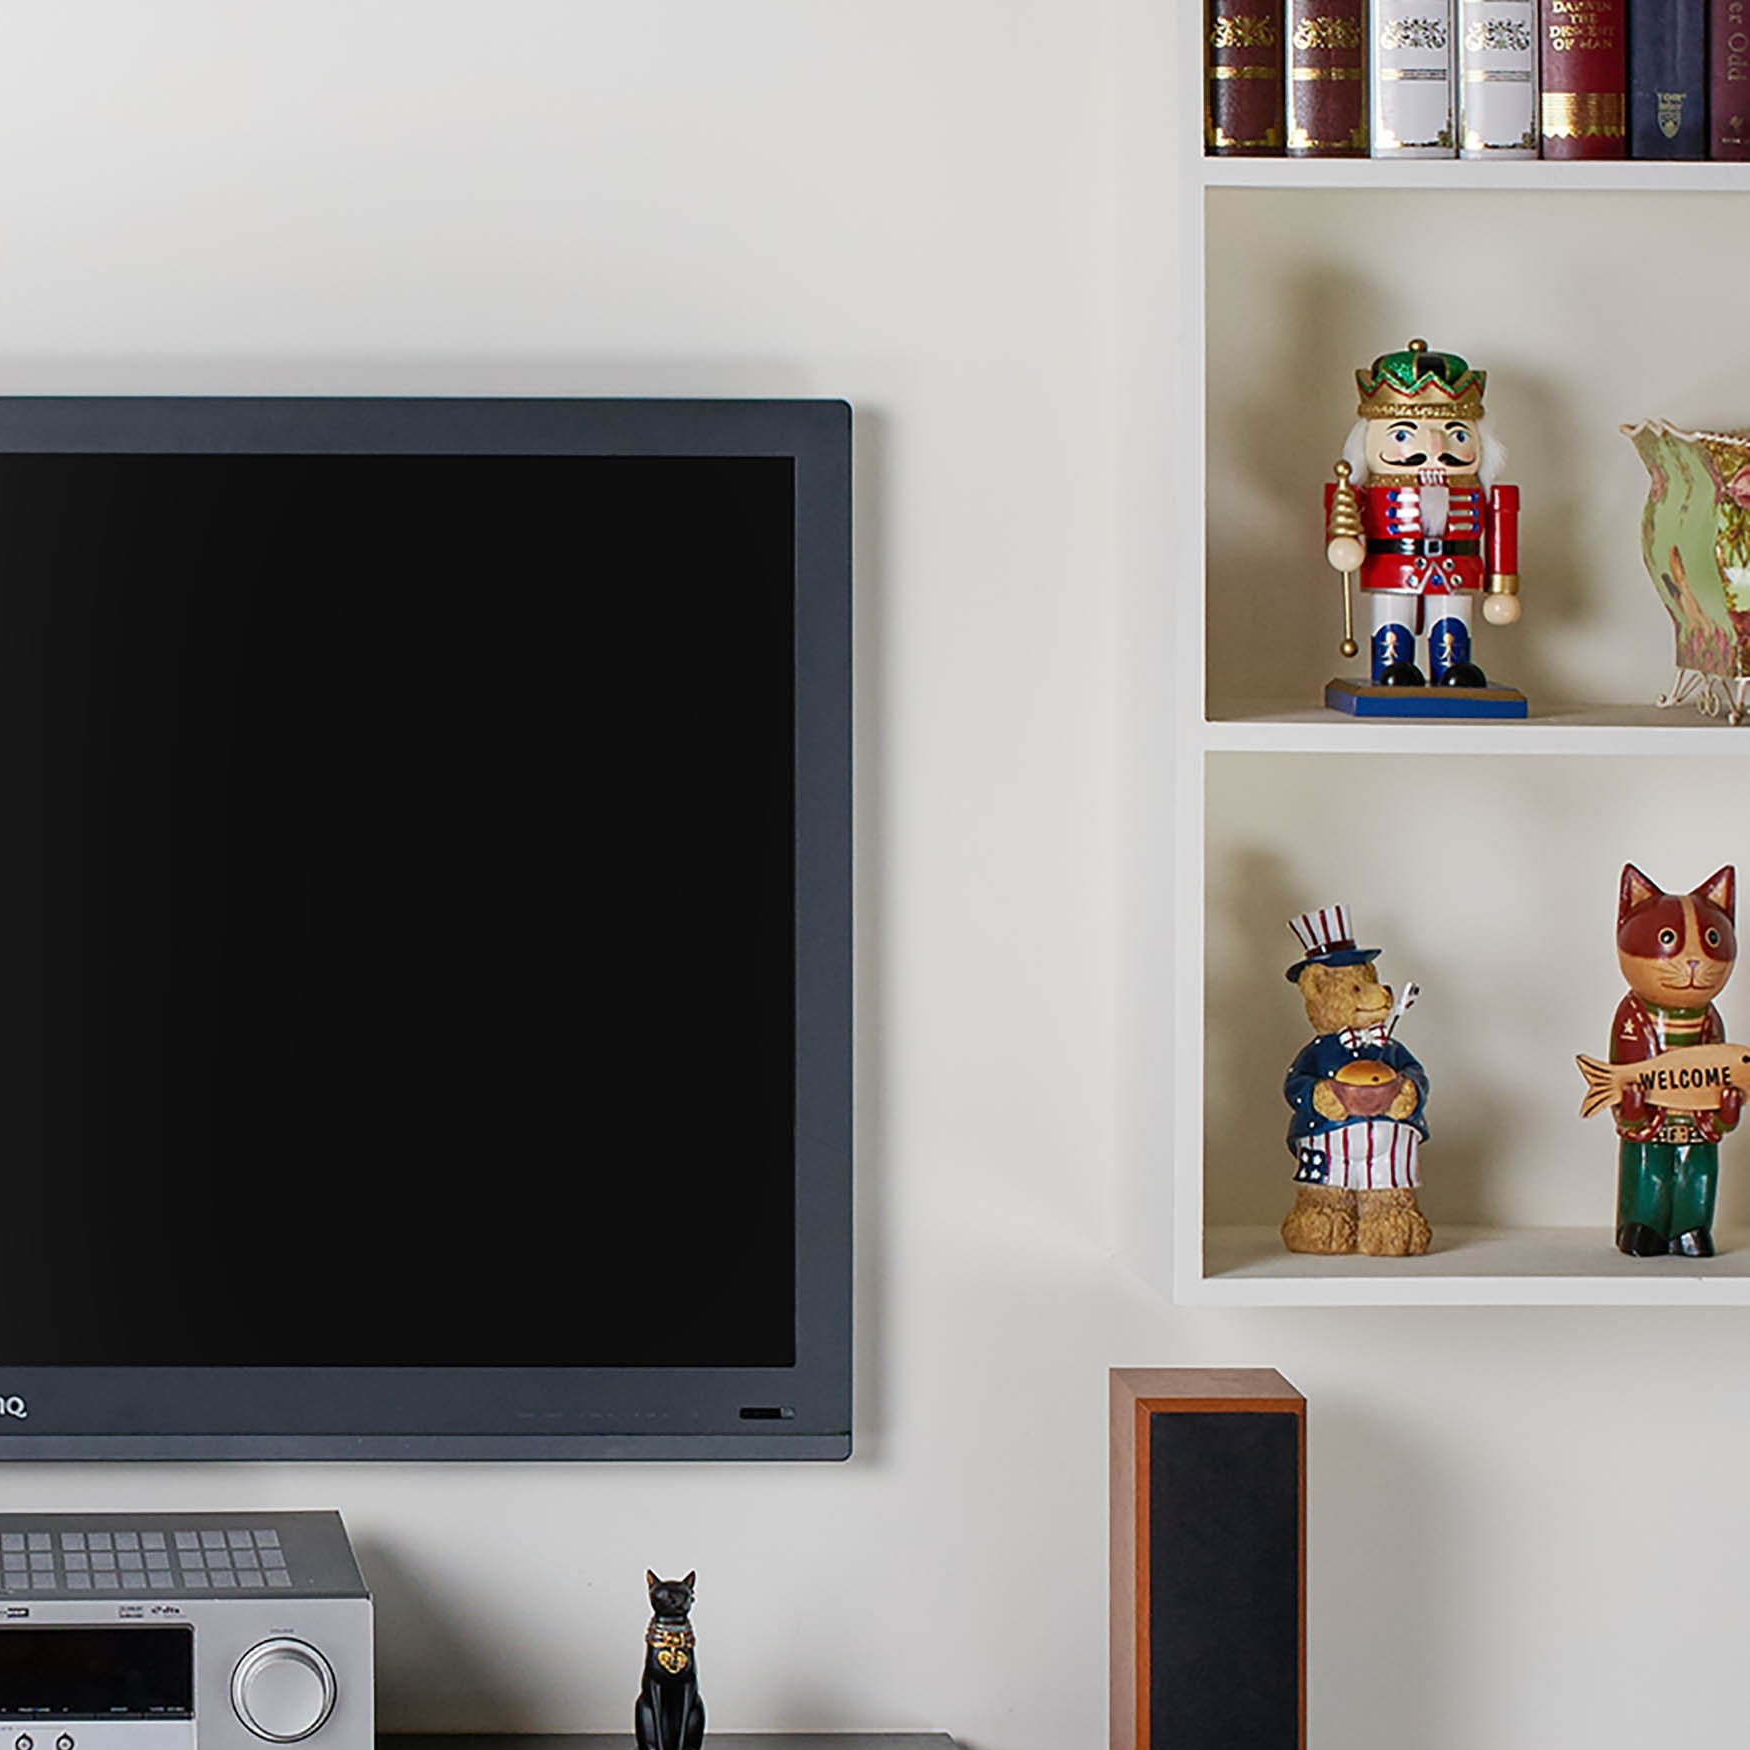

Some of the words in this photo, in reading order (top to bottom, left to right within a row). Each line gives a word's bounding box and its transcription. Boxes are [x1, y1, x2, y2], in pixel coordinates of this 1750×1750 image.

[1552, 38, 1575, 51] OF
[1728, 33, 1748, 81] Odd
[1639, 1066, 1731, 1090] WELCOME
